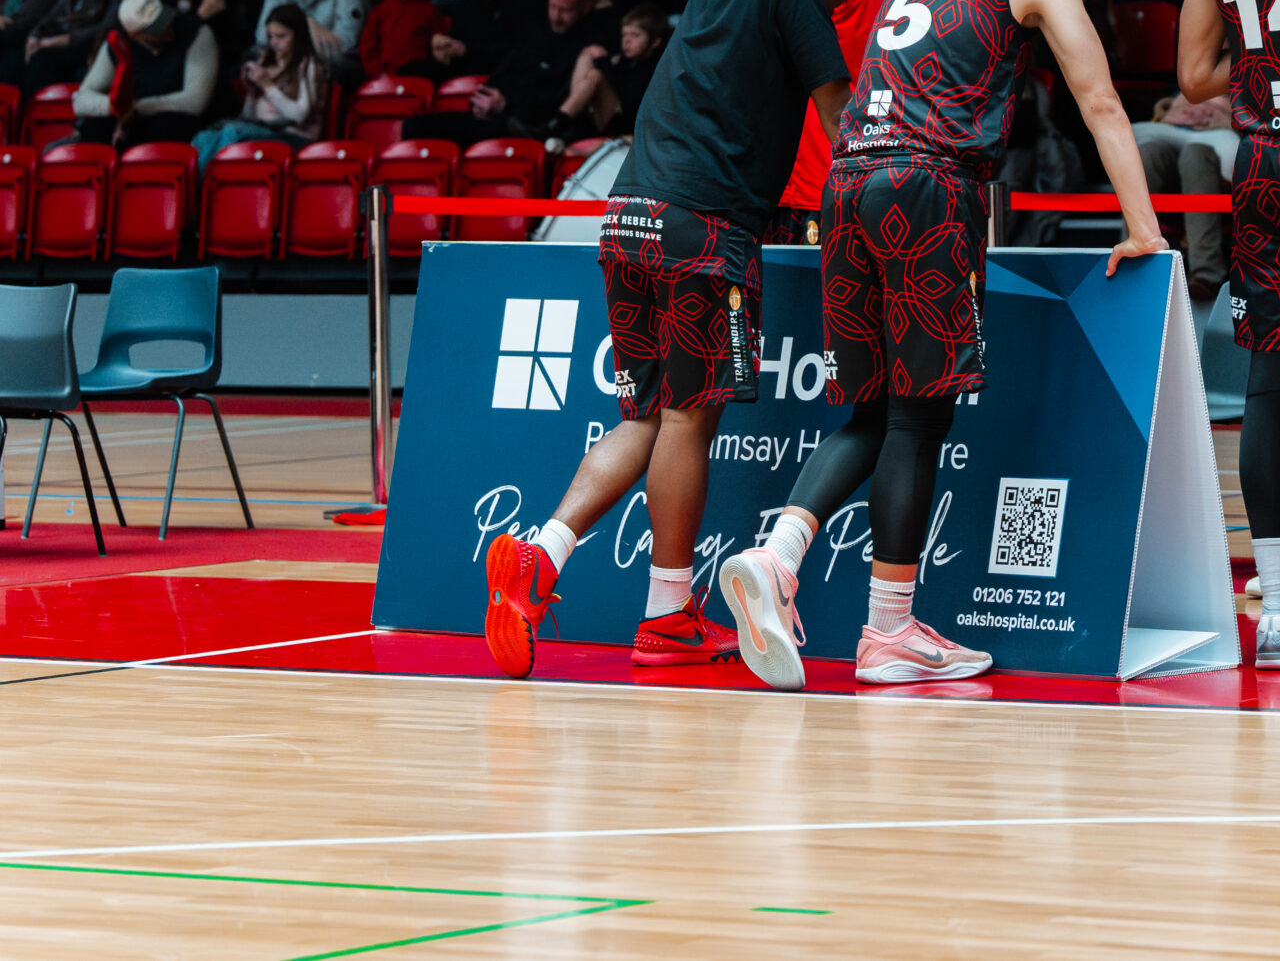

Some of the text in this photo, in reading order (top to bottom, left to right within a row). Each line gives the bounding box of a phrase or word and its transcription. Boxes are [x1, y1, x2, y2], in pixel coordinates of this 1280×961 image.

[863, 122, 891, 136] Oaks
[621, 215, 664, 229] REBELS
[605, 229, 634, 237] CURIOUS
[635, 230, 662, 241] BRAVE
[729, 310, 744, 383] TRAILFINDERS
[708, 433, 790, 471] msay
[972, 586, 1066, 607] 01206 752 121
[956, 610, 1076, 632] oakshospital.co.uk
